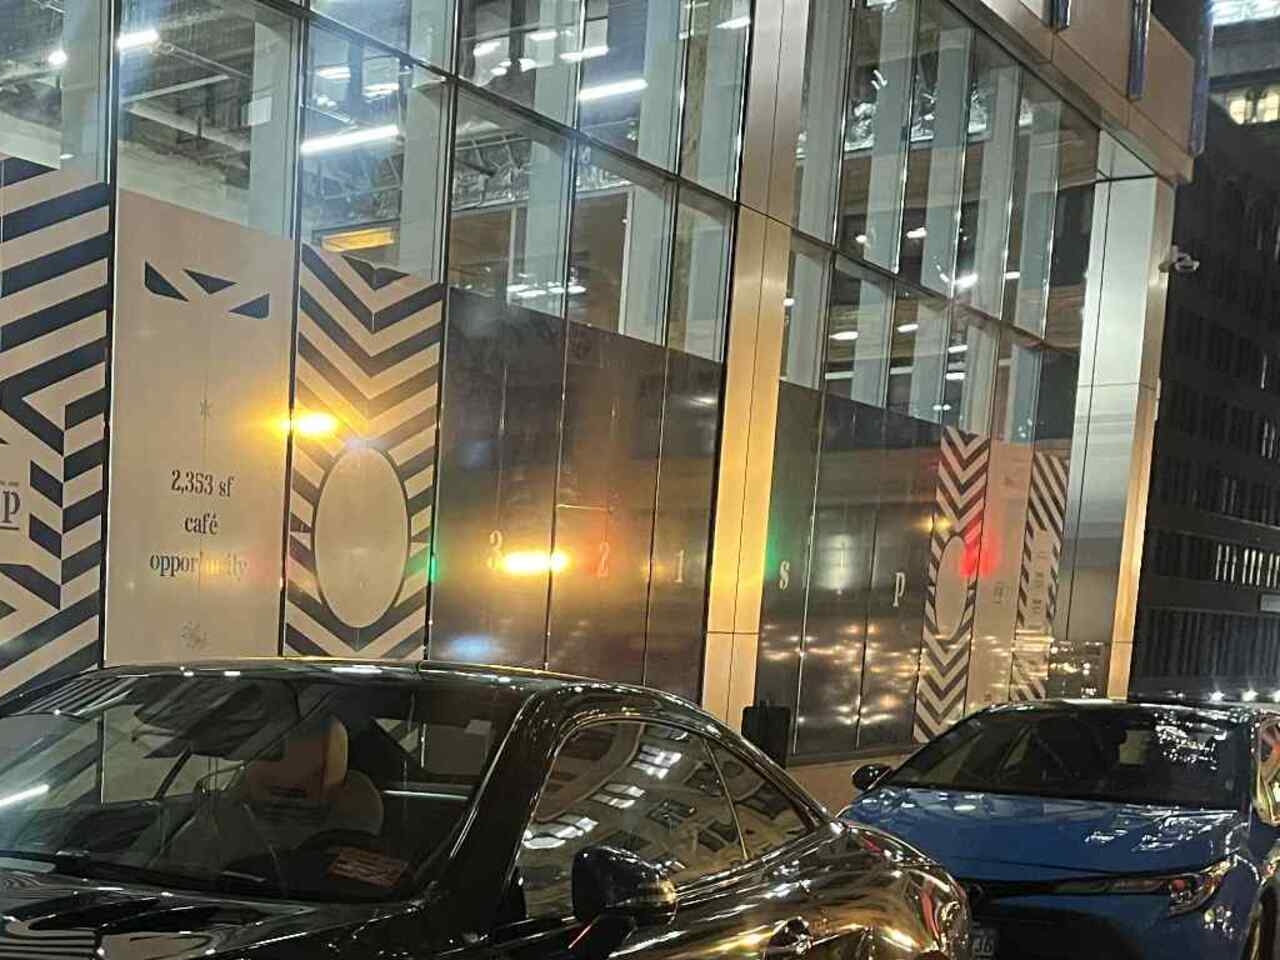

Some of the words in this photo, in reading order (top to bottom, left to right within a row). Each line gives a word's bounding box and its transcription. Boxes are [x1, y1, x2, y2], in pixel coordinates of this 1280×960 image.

[170, 469, 213, 495] 2,353
[219, 476, 235, 498] sf
[184, 512, 218, 536] café
[149, 551, 248, 582] opporunity
